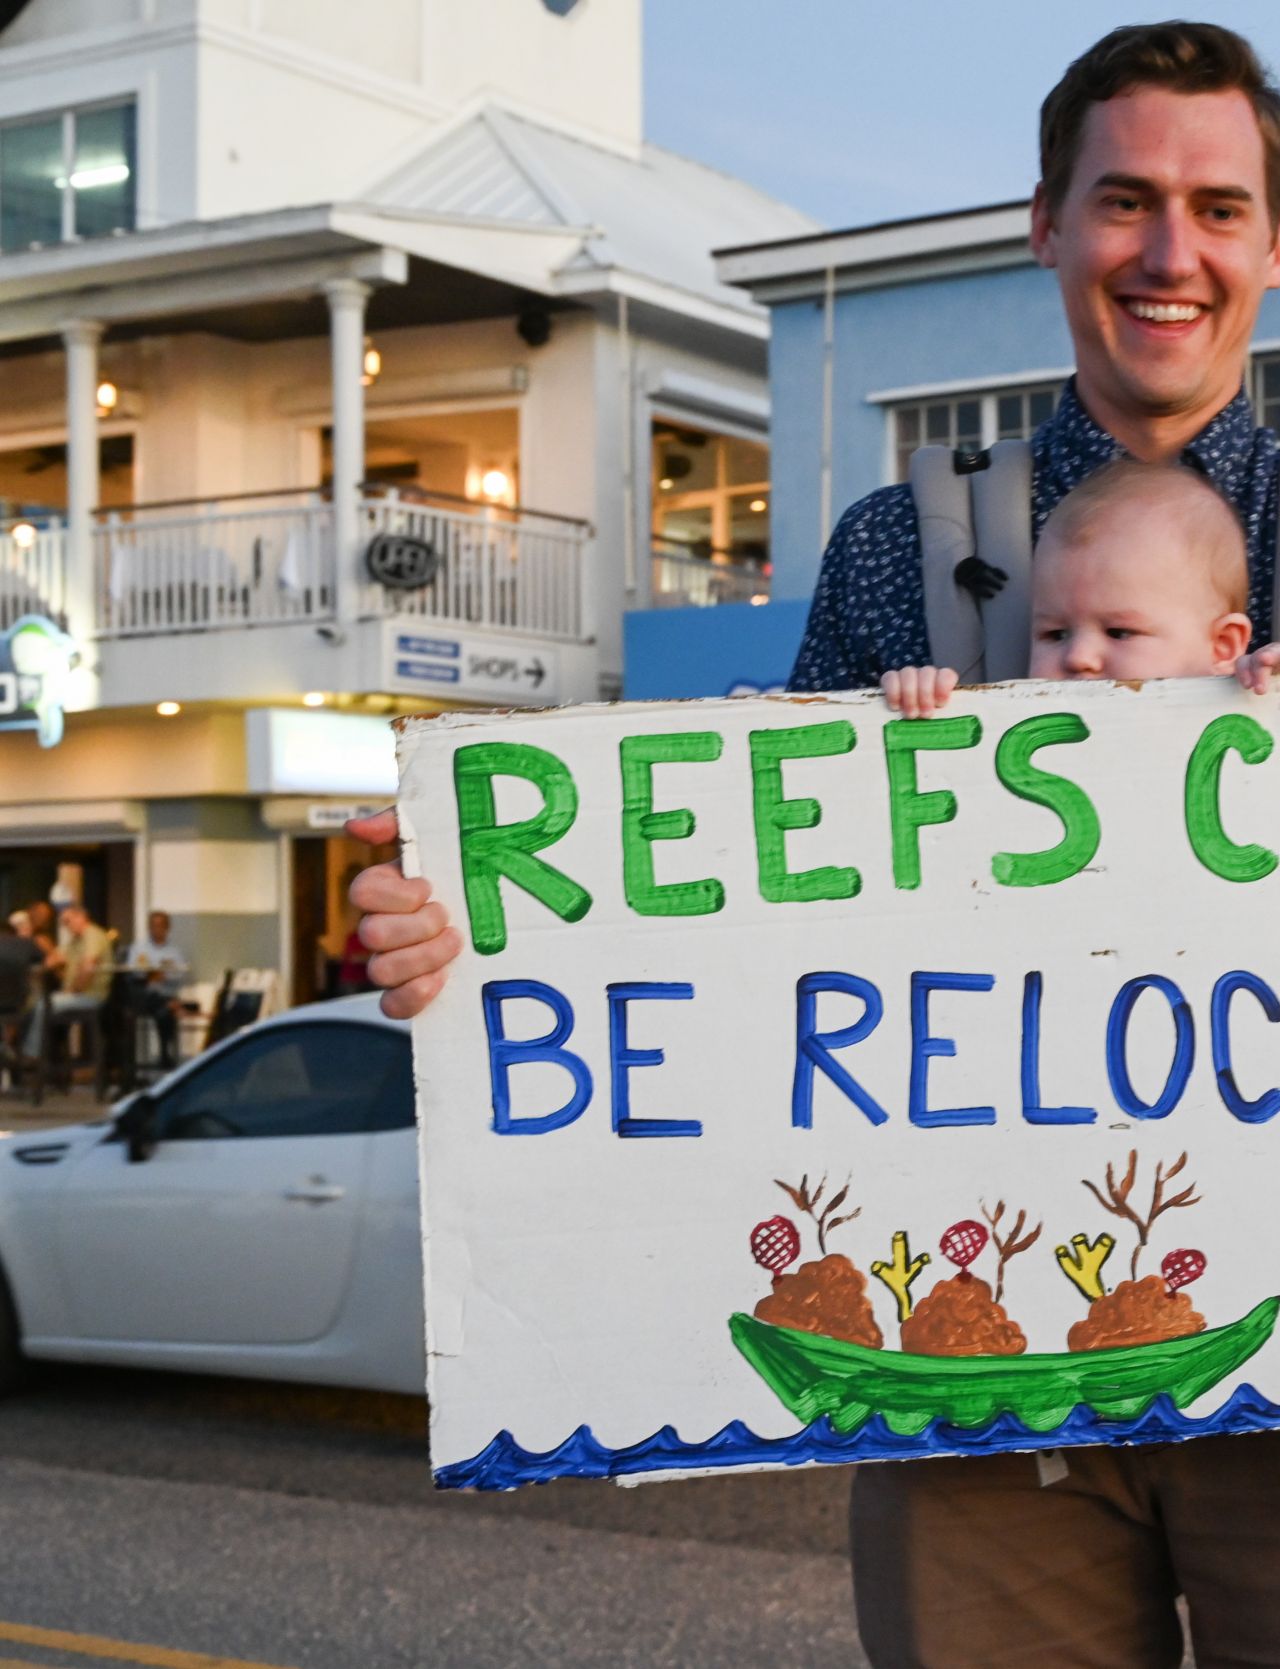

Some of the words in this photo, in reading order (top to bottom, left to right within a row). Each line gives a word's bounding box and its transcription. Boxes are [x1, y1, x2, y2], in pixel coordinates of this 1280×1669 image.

[468, 654, 519, 681] SHOPS
[453, 712, 1101, 955] REEFS
[482, 979, 703, 1137] BE
